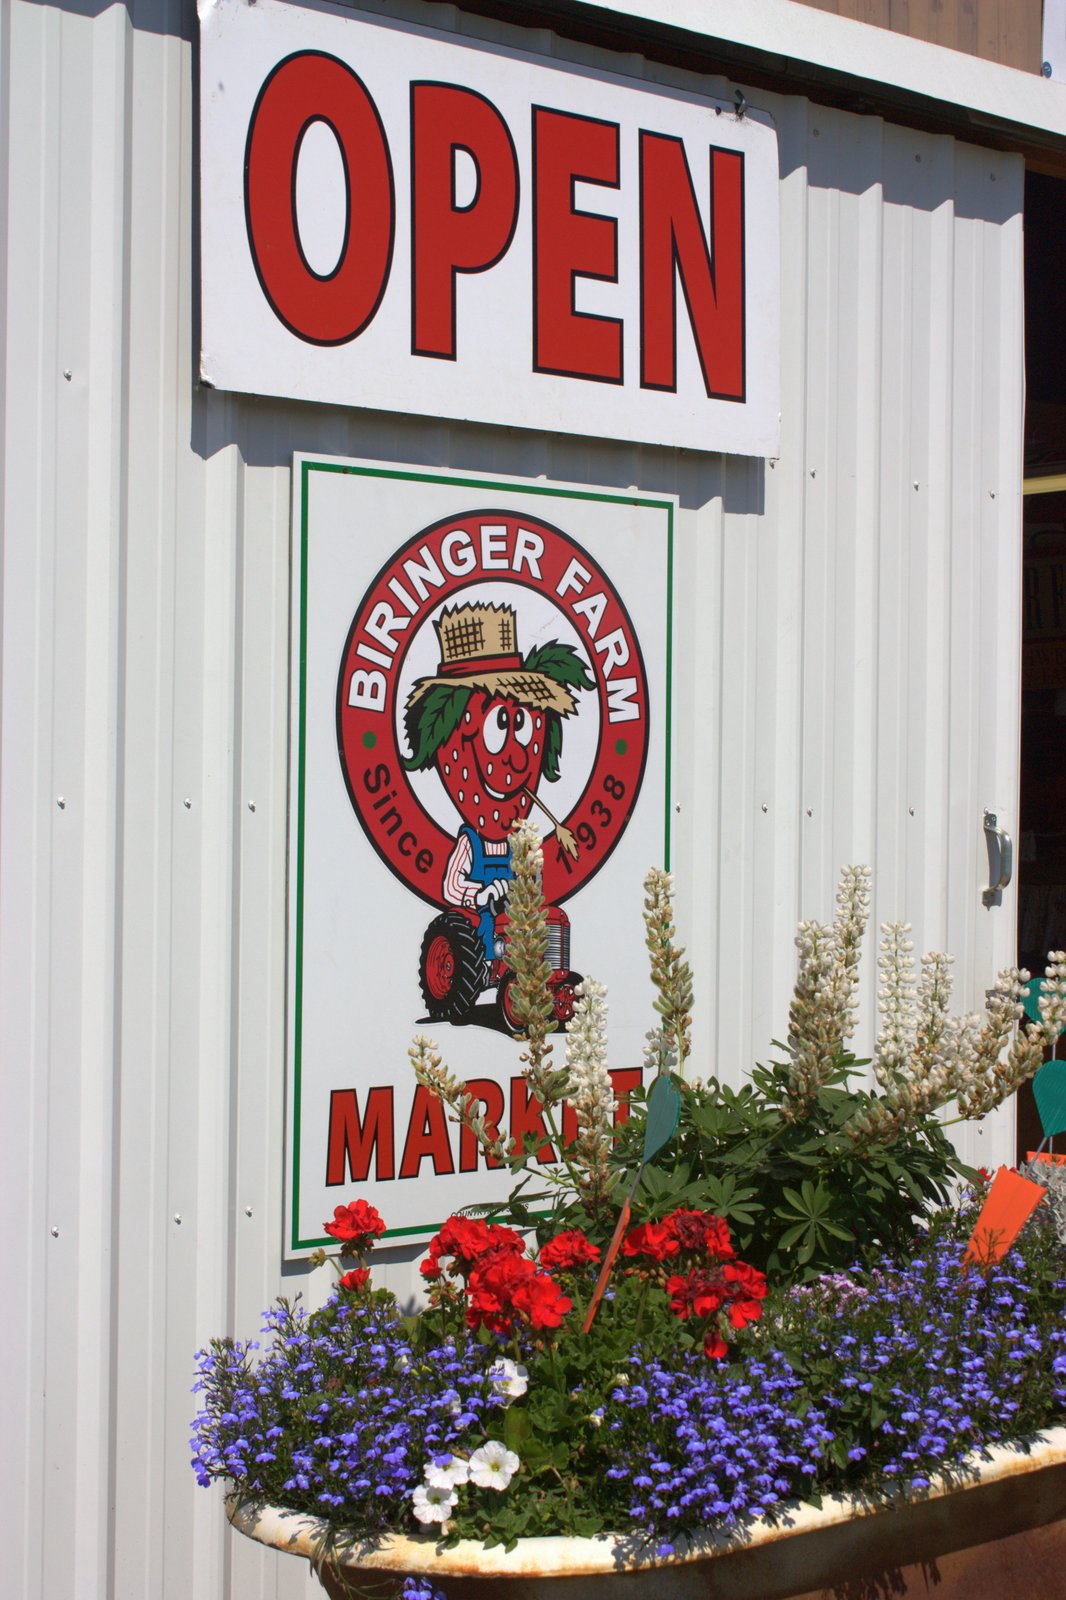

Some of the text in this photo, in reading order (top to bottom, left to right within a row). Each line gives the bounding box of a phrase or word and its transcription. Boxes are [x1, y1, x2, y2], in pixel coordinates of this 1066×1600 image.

[244, 49, 746, 404] OPEN
[348, 524, 641, 724] BIRINGER FARM
[362, 762, 625, 875] Since 1938
